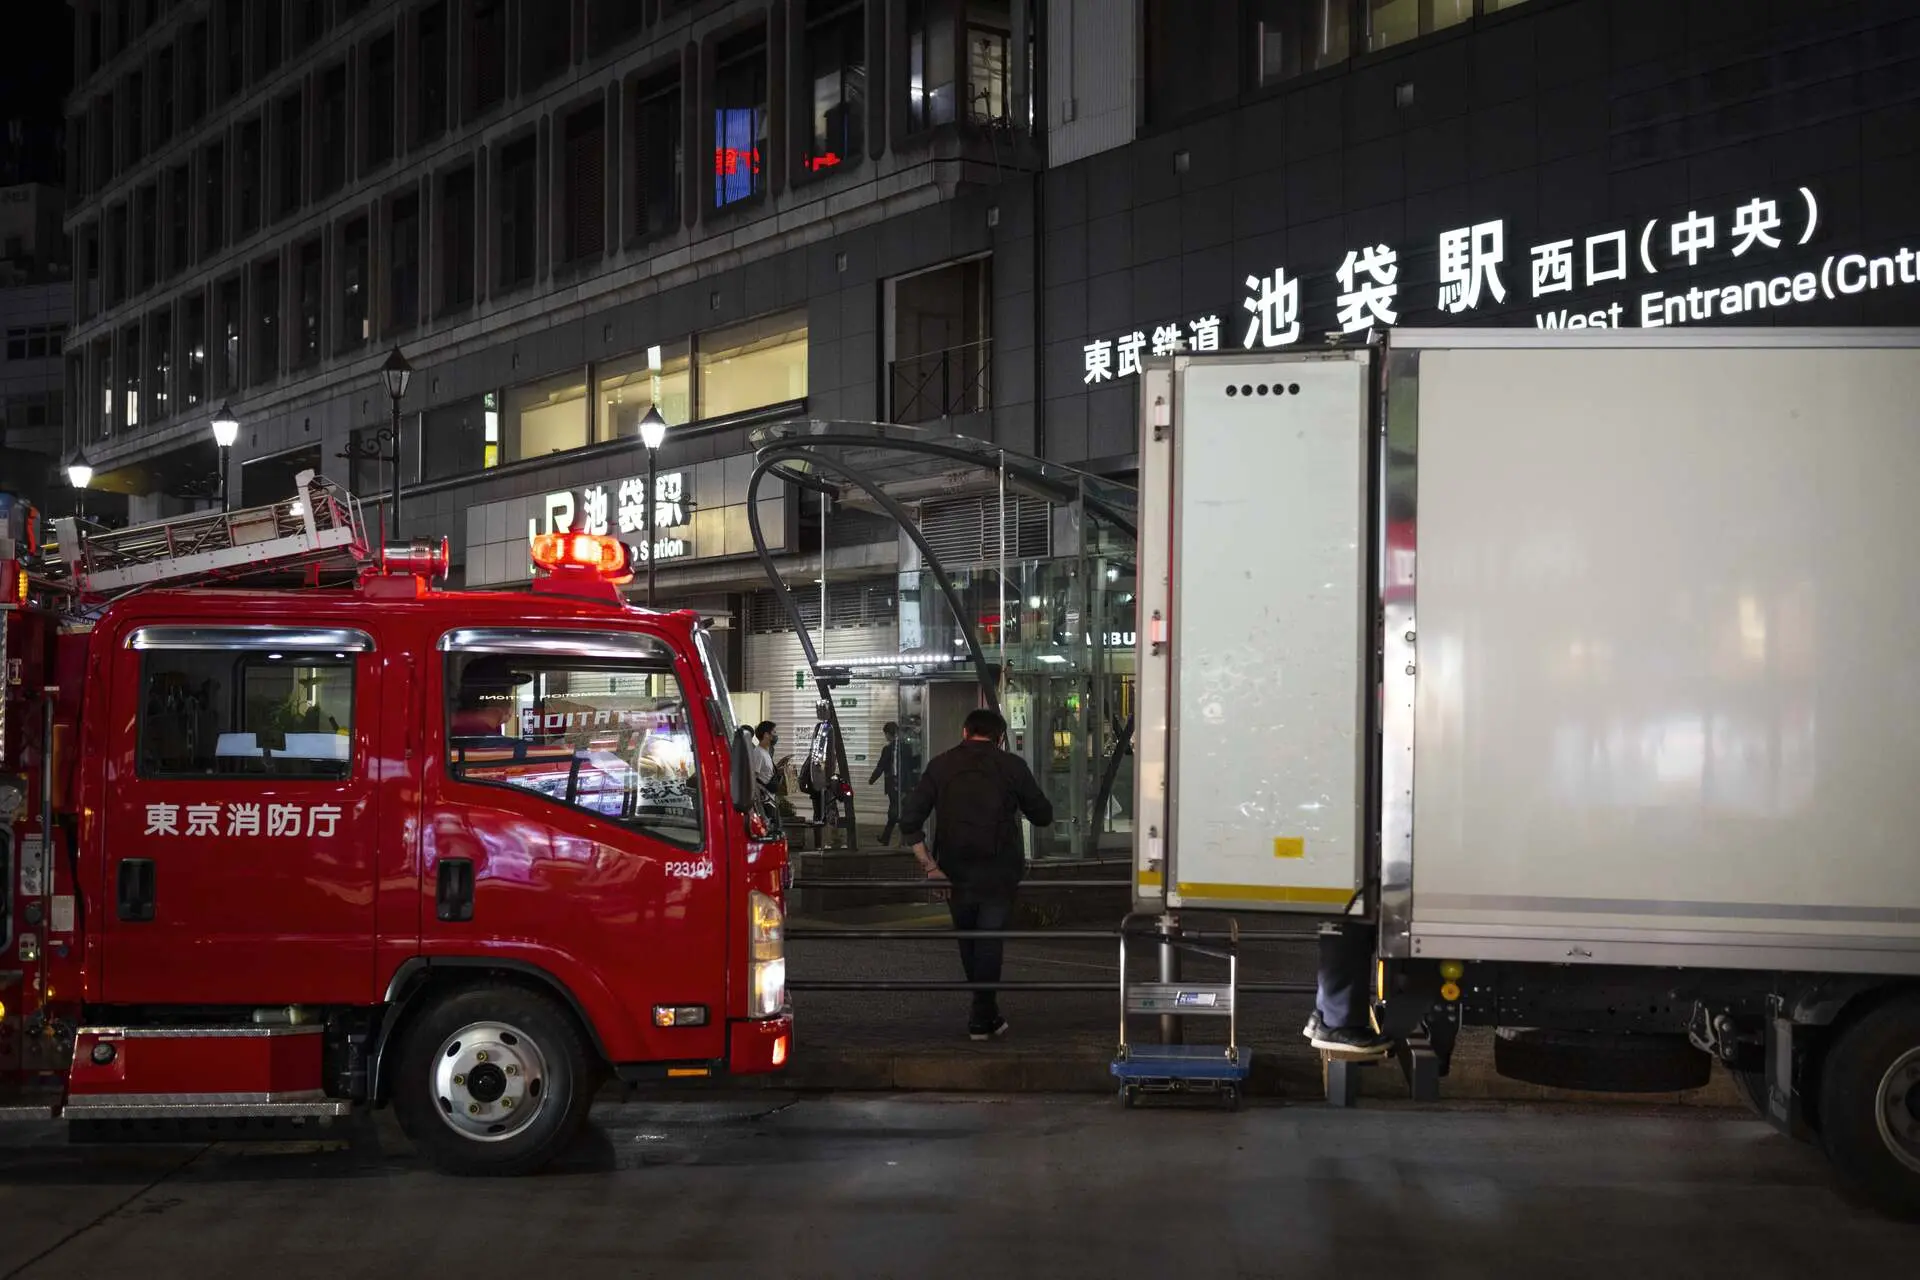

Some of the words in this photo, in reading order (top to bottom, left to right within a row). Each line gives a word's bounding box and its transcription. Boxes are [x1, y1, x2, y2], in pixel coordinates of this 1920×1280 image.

[1083, 314, 1220, 384] 東武鉄道
[1244, 219, 1506, 349] 池袋駅
[1536, 302, 1623, 329] West
[639, 537, 684, 560] Sation
[143, 802, 342, 838] 東京消防庁
[665, 861, 713, 877] P23104
